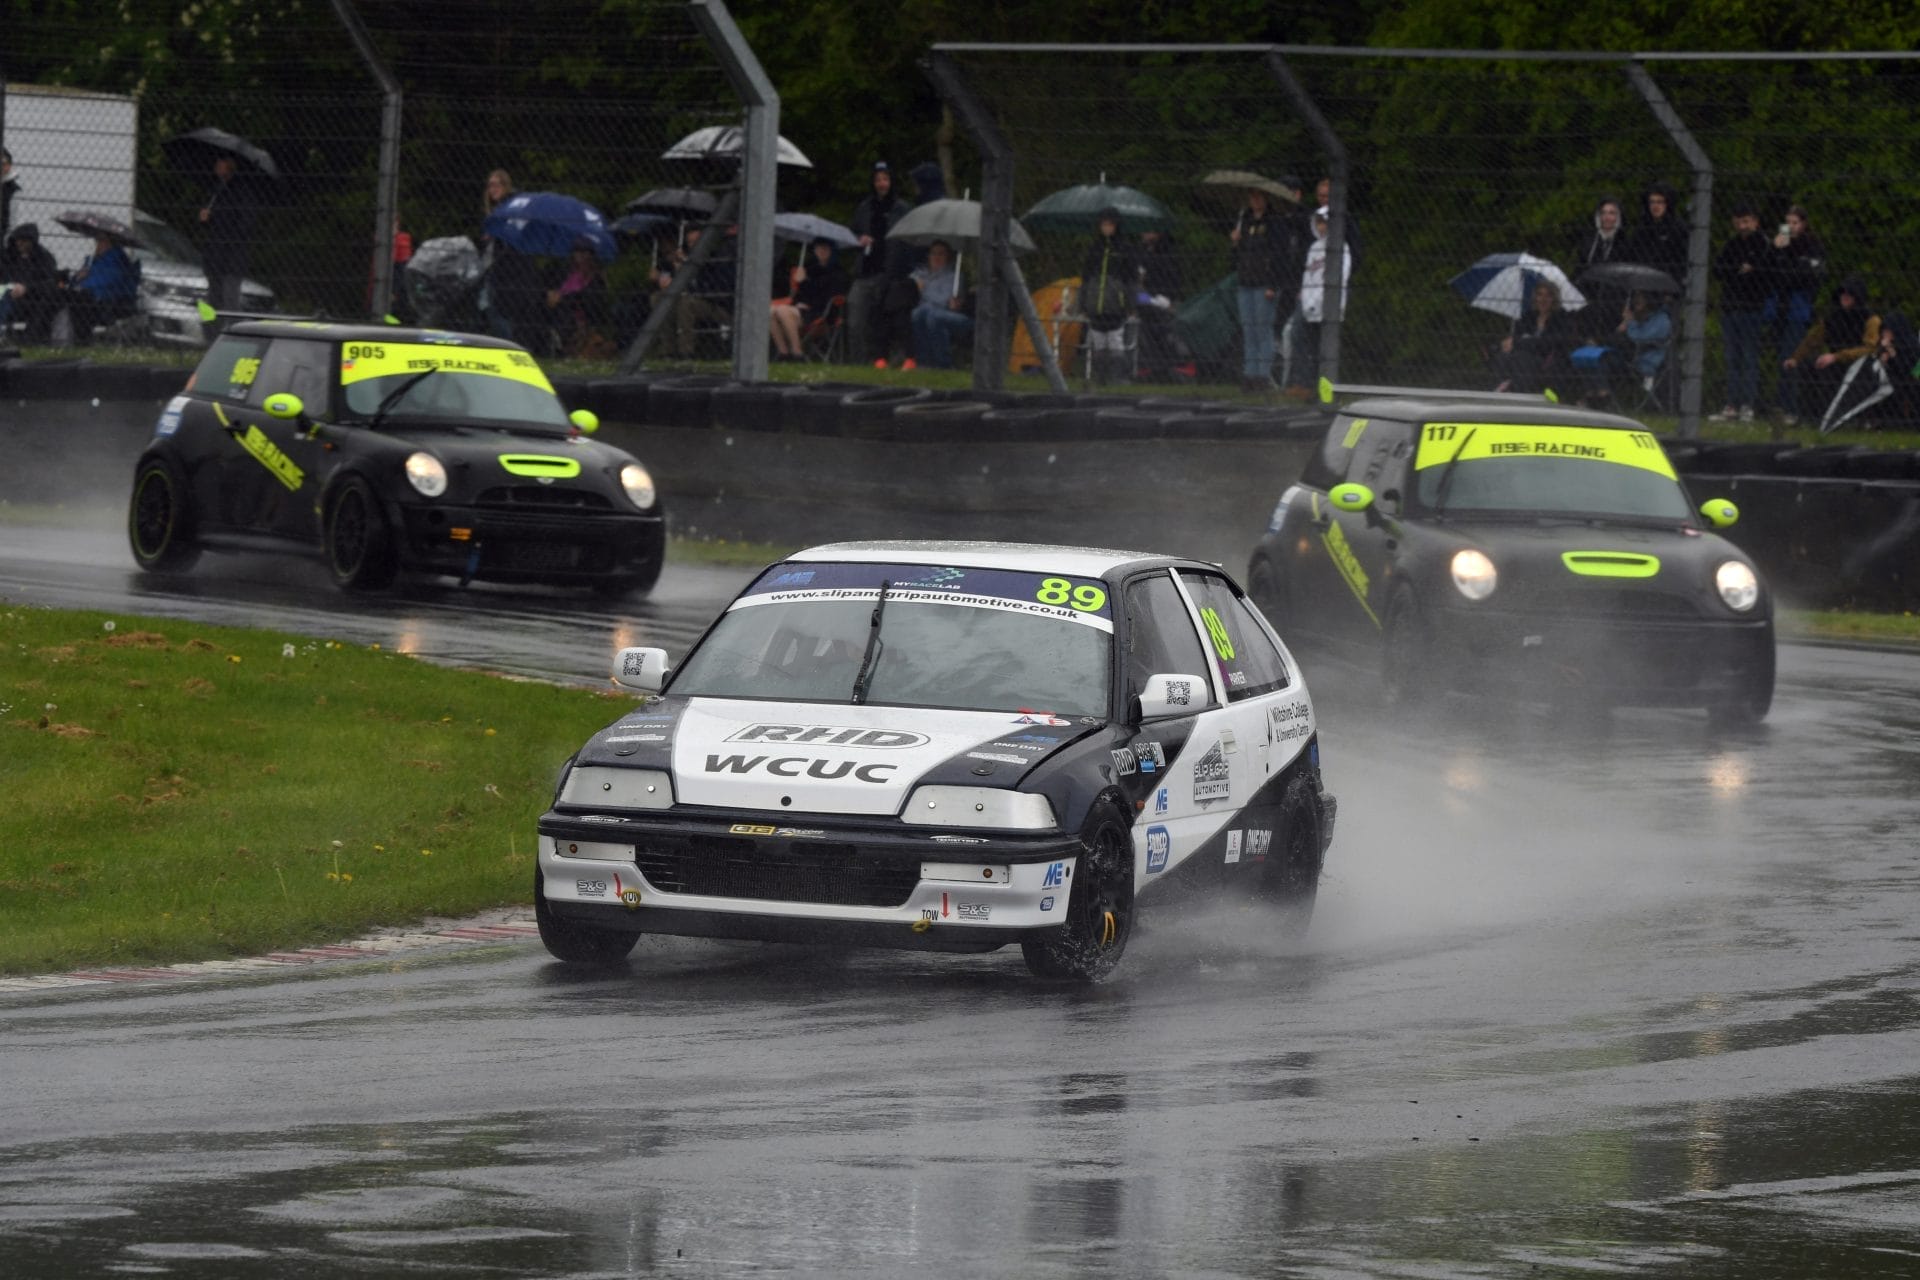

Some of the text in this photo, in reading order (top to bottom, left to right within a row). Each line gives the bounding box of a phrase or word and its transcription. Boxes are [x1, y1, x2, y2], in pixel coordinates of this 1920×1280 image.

[349, 346, 385, 360] 905
[443, 359, 501, 373] RACING
[1427, 426, 1457, 441] 117
[1534, 442, 1606, 458] RACING
[1036, 577, 1106, 612] 89
[738, 725, 919, 747] RHD
[704, 754, 898, 784] WCUC
[1195, 783, 1230, 796] AUTOMOTIVE
[578, 880, 606, 892] S&G
[922, 909, 939, 921] TOW
[958, 903, 991, 915] S&G
